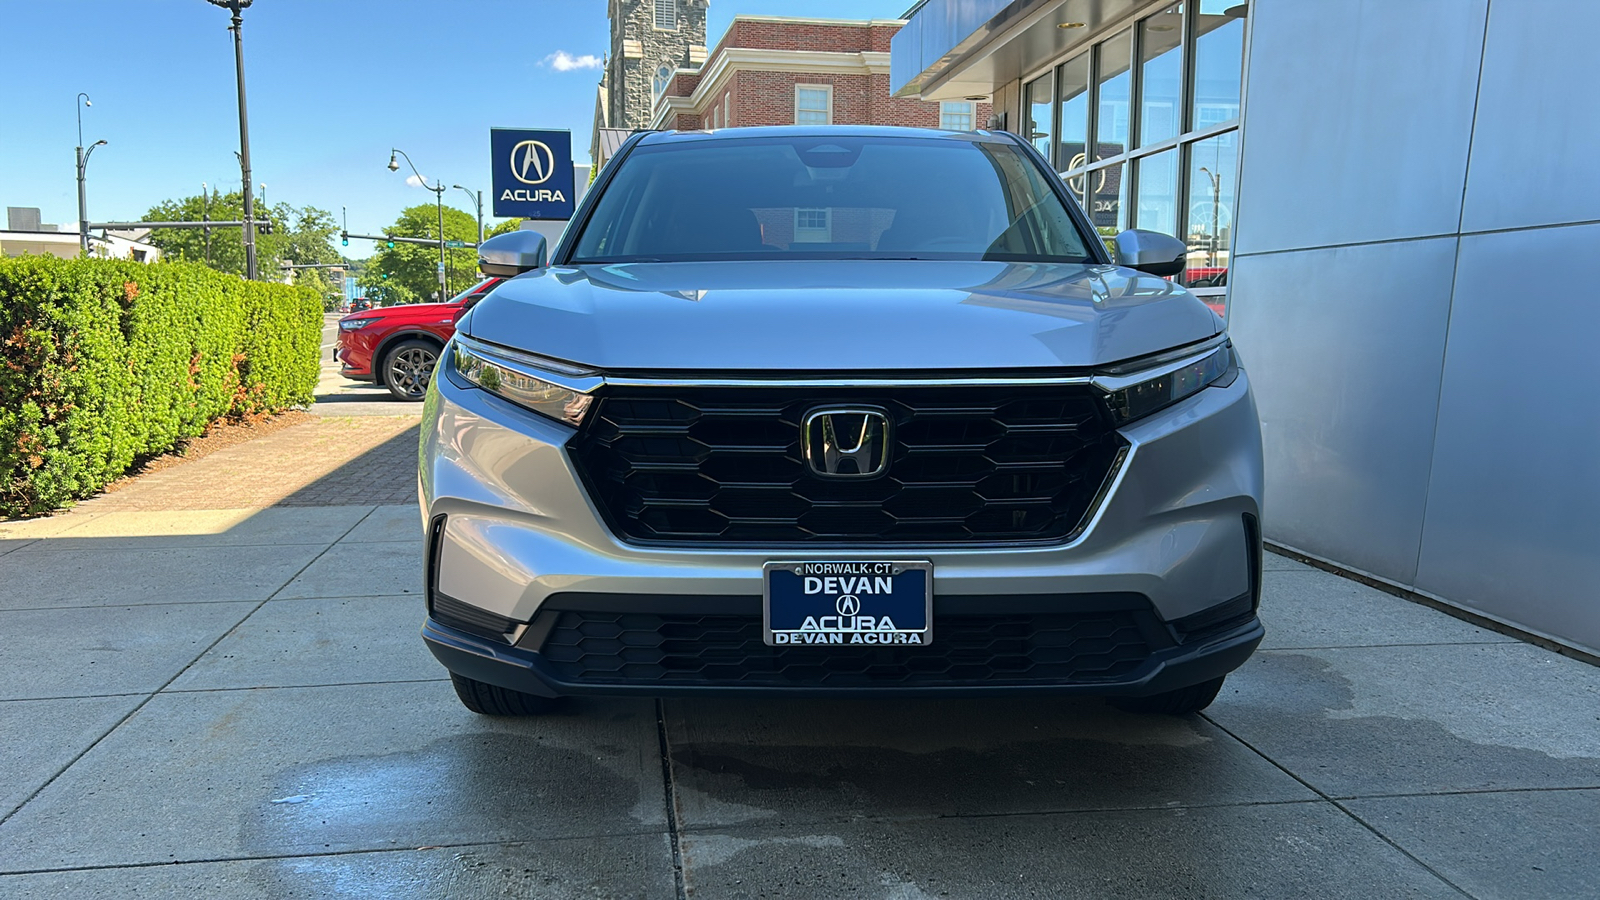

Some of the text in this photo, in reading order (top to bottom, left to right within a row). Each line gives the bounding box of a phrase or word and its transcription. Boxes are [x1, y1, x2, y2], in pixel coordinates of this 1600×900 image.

[501, 189, 566, 203] ACURA
[805, 563, 892, 574] NORWALK, CT
[804, 577, 892, 594] DEVAN
[800, 616, 897, 631] ACURA
[775, 633, 922, 644] DEVAN ACURA
